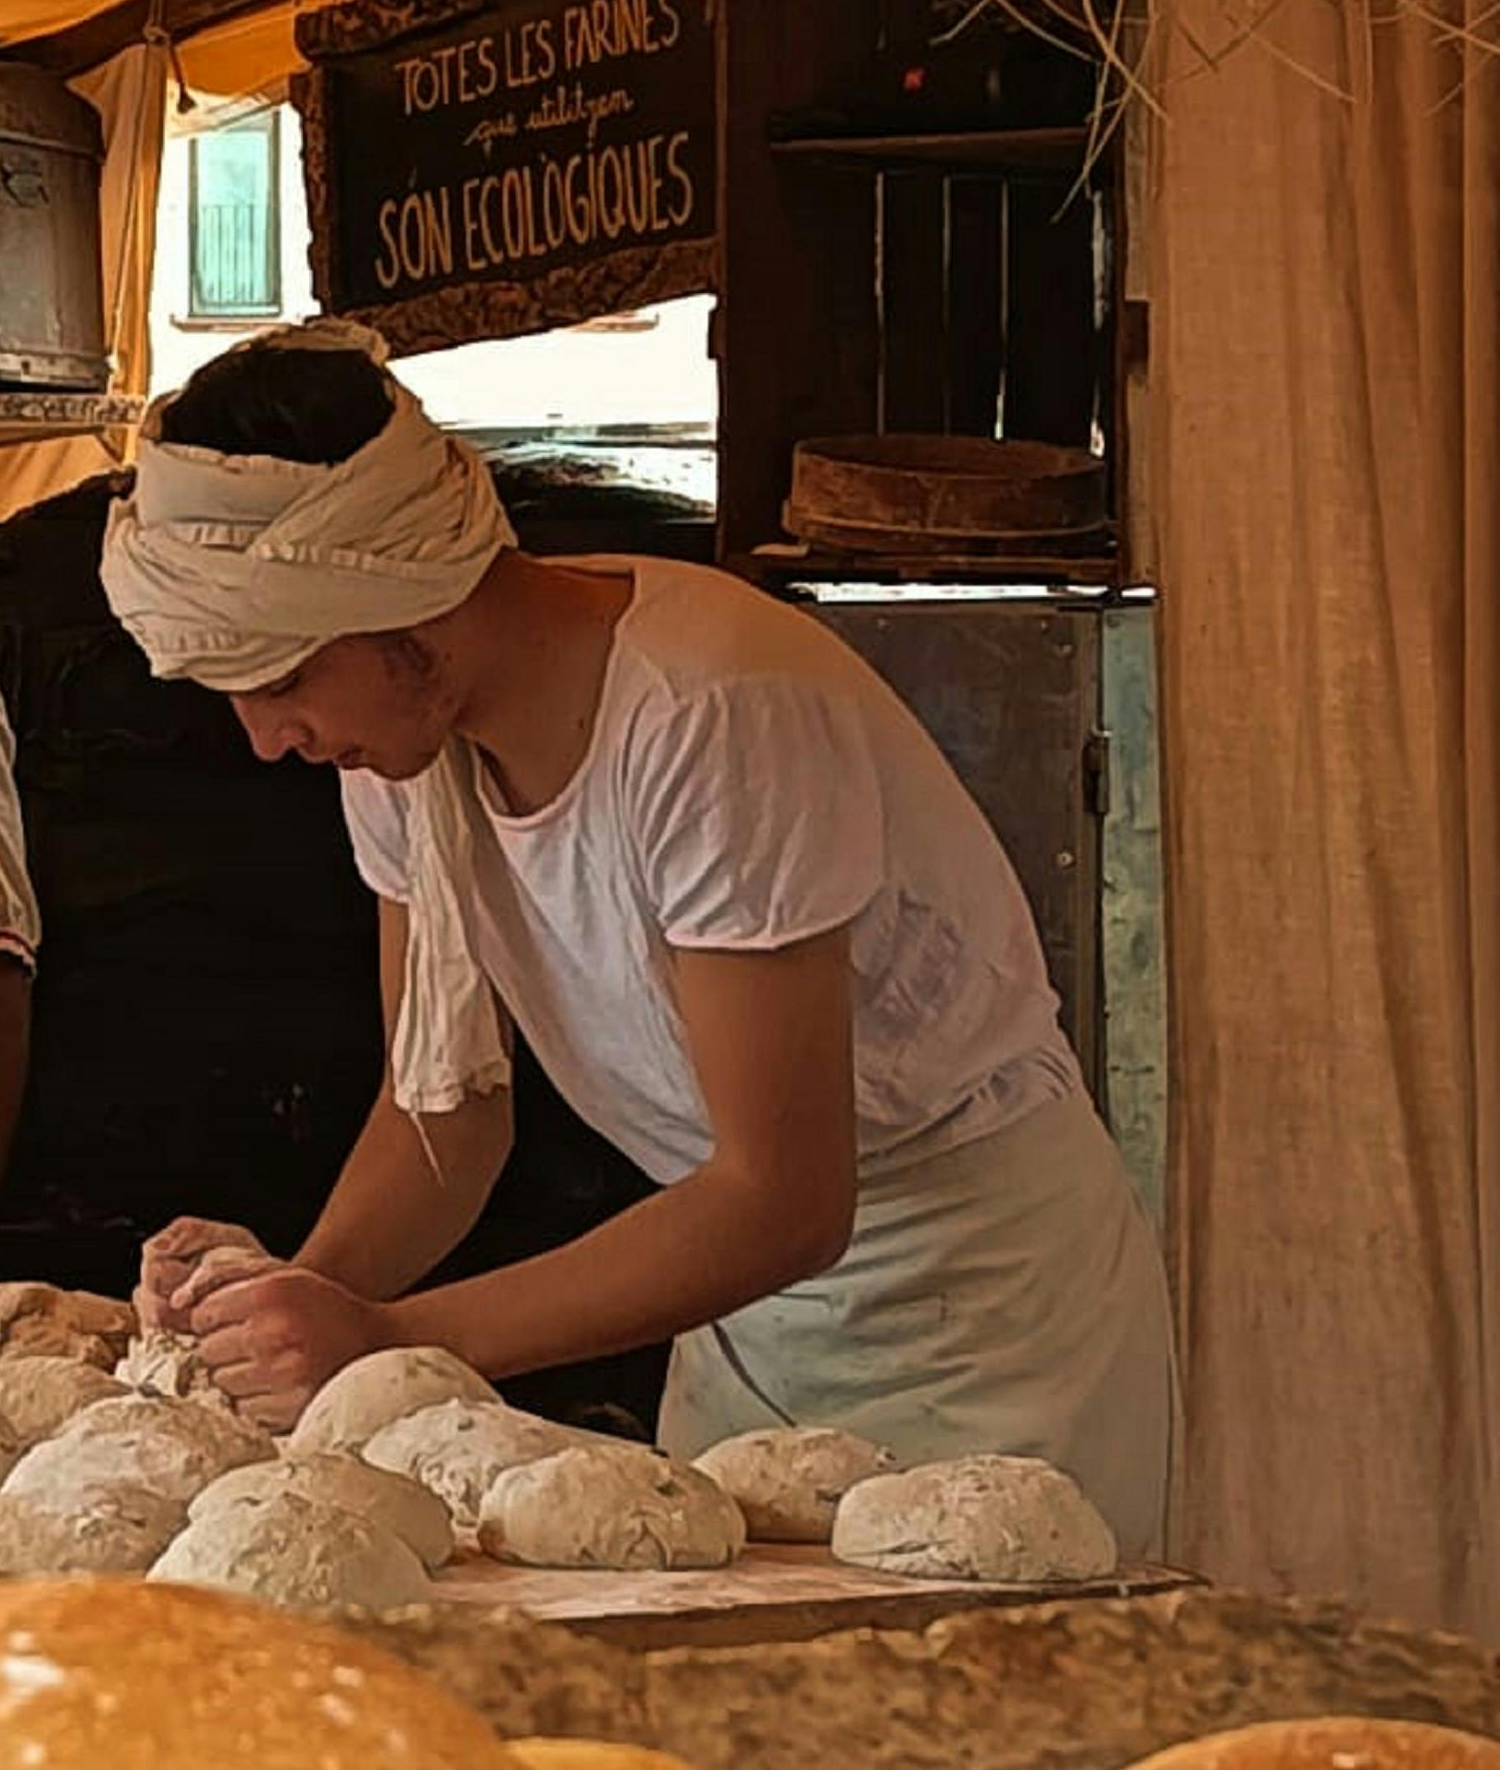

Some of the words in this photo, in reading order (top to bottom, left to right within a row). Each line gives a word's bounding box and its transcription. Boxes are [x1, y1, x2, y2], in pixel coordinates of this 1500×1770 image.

[395, 39, 496, 115] TOTES
[505, 21, 556, 89] LES
[463, 110, 518, 156] que
